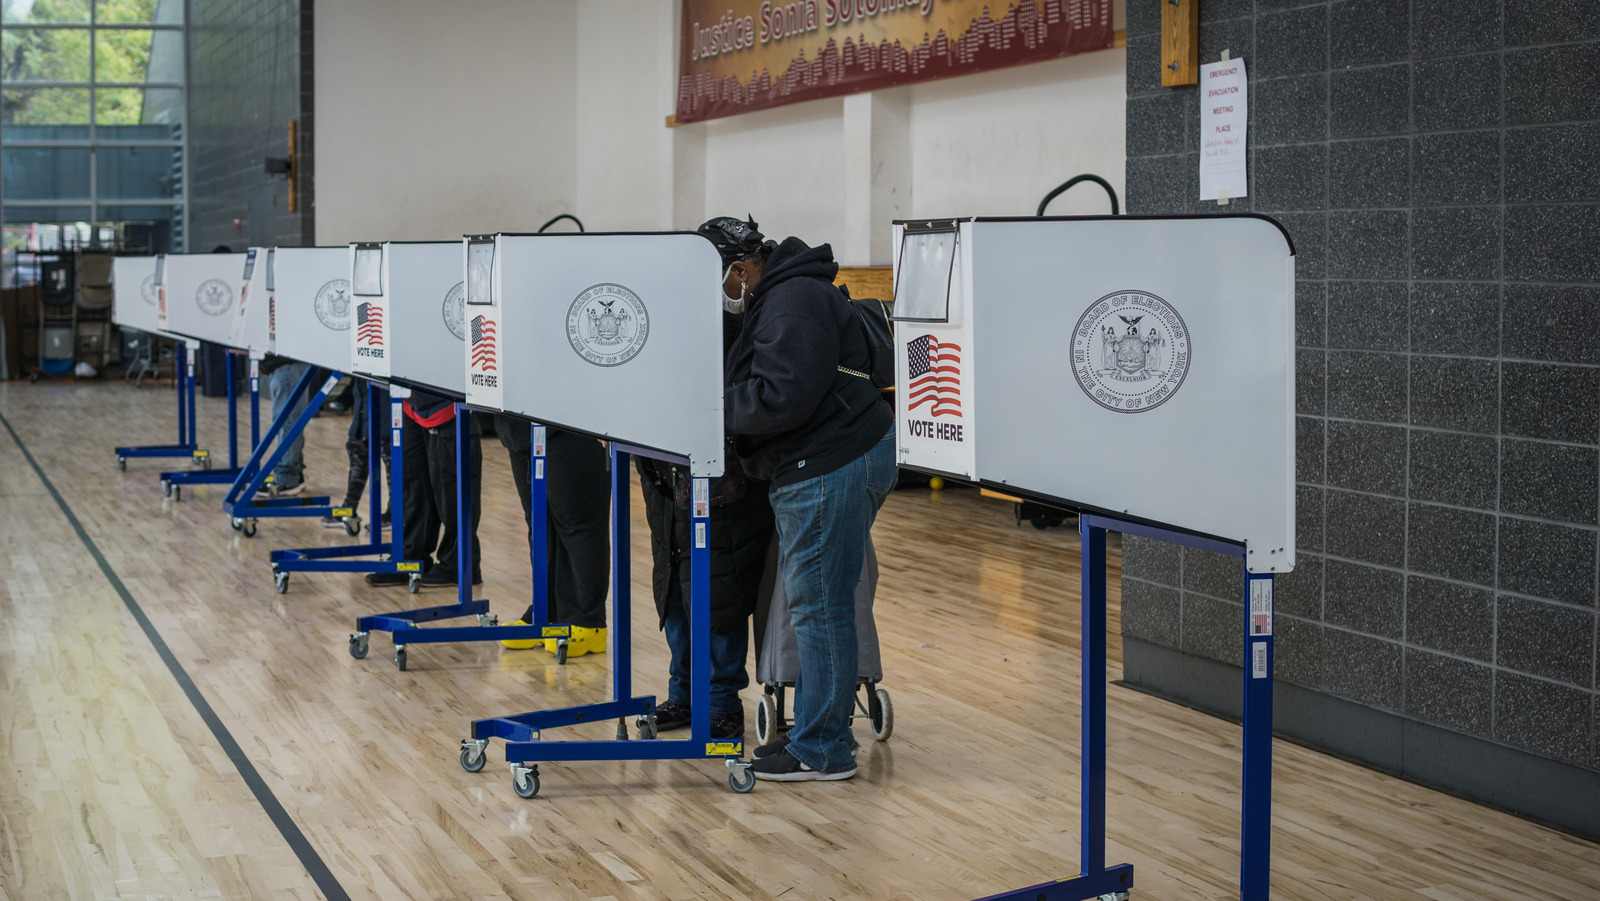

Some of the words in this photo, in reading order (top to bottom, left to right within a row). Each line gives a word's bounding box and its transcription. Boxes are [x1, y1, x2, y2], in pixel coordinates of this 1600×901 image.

[692, 9, 755, 61] Justice
[760, 0, 818, 43] Sonia
[1209, 67, 1238, 78] EMERGENCY
[1209, 86, 1239, 97] EVACUATION
[1213, 105, 1234, 115] MEETING
[1216, 124, 1231, 133] PLACE
[1078, 302, 1109, 337] BOARD
[1111, 295, 1127, 307] OF
[1131, 295, 1184, 339] ELECTIONS
[357, 346, 370, 357] VOTE
[371, 348, 384, 359] HERE
[1075, 349, 1084, 363] IN
[1168, 351, 1187, 384] YORK
[470, 373, 484, 386] VOTE
[484, 374, 498, 388] HERE
[1079, 365, 1096, 390] THE
[1095, 388, 1123, 407] CITY
[1145, 384, 1170, 405] NEW
[1125, 398, 1142, 408] OF
[908, 419, 933, 438] VOTE
[936, 422, 963, 442] HERE
